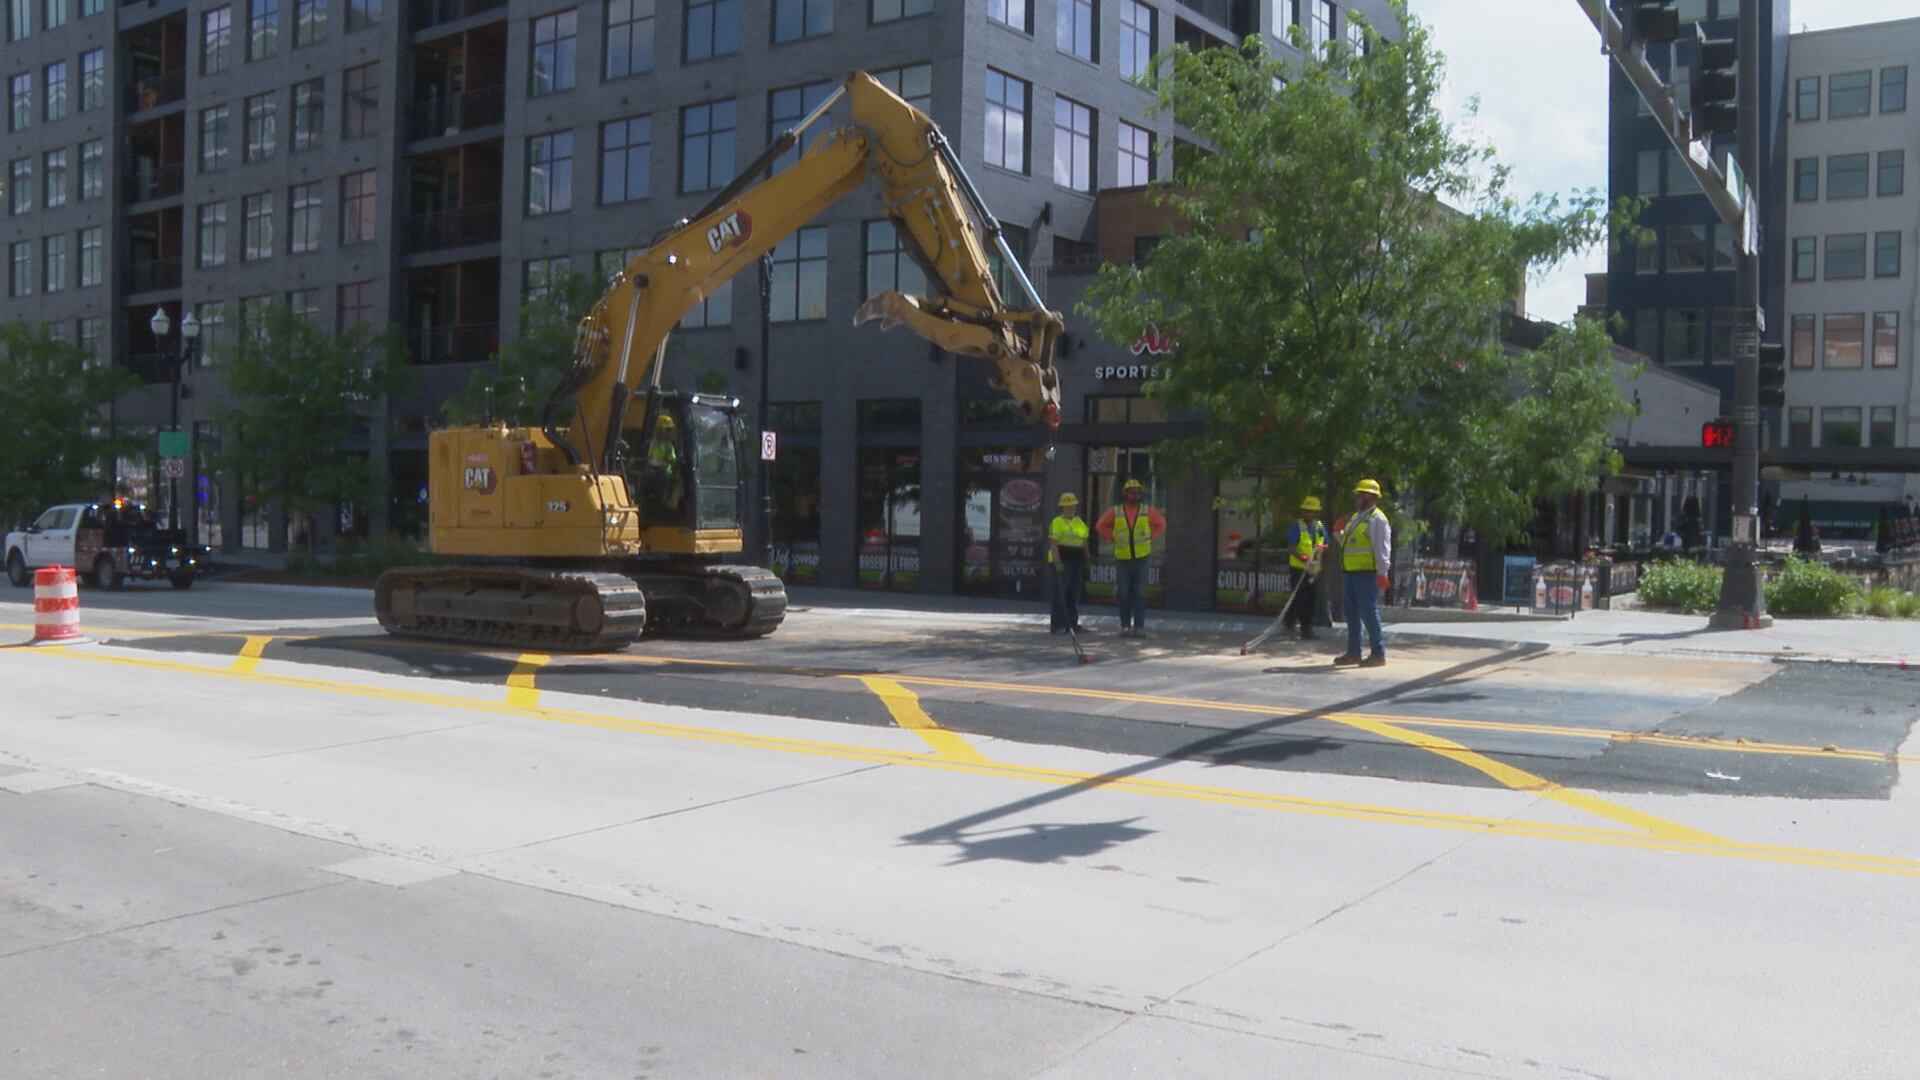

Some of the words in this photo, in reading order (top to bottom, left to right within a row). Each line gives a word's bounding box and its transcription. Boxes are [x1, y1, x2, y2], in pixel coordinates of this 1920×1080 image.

[707, 212, 742, 253] CAT
[1095, 365, 1160, 379] SPORTS
[465, 467, 490, 489] CAT
[1003, 567, 1036, 577] ULTRA
[1090, 565, 1118, 584] GREA
[1218, 570, 1246, 590] COLD
